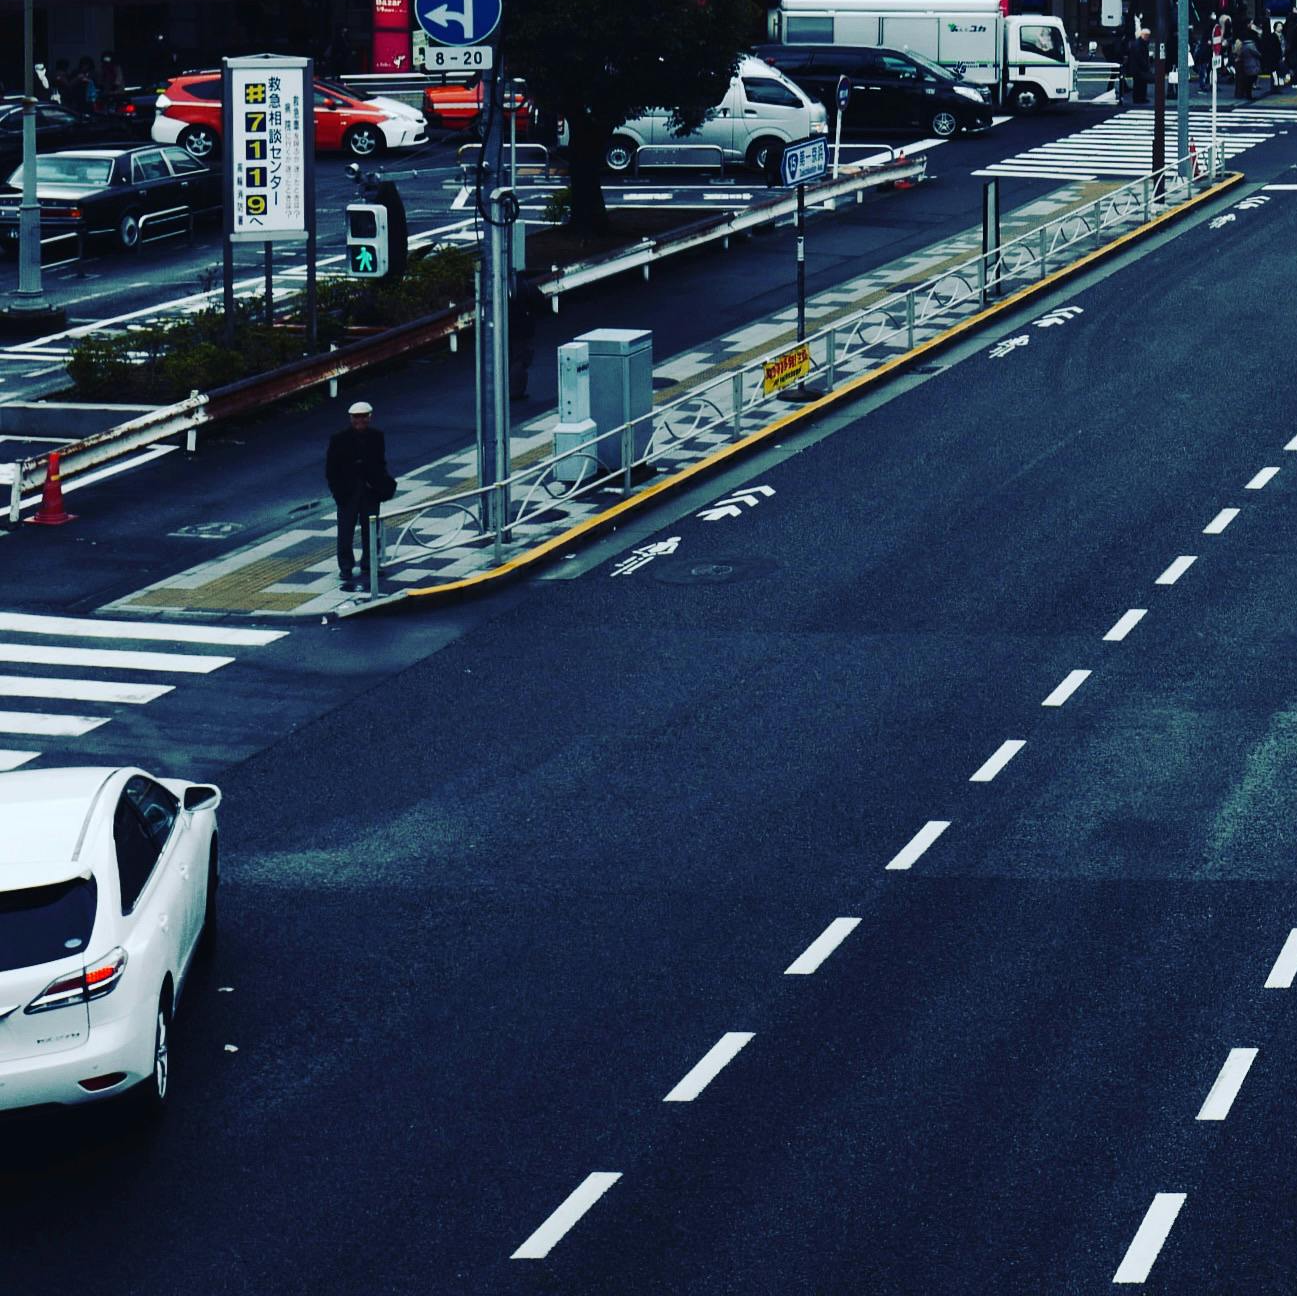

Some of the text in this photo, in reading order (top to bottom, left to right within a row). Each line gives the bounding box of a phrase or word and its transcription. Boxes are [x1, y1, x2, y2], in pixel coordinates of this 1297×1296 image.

[268, 76, 282, 206] 救急相談センター
